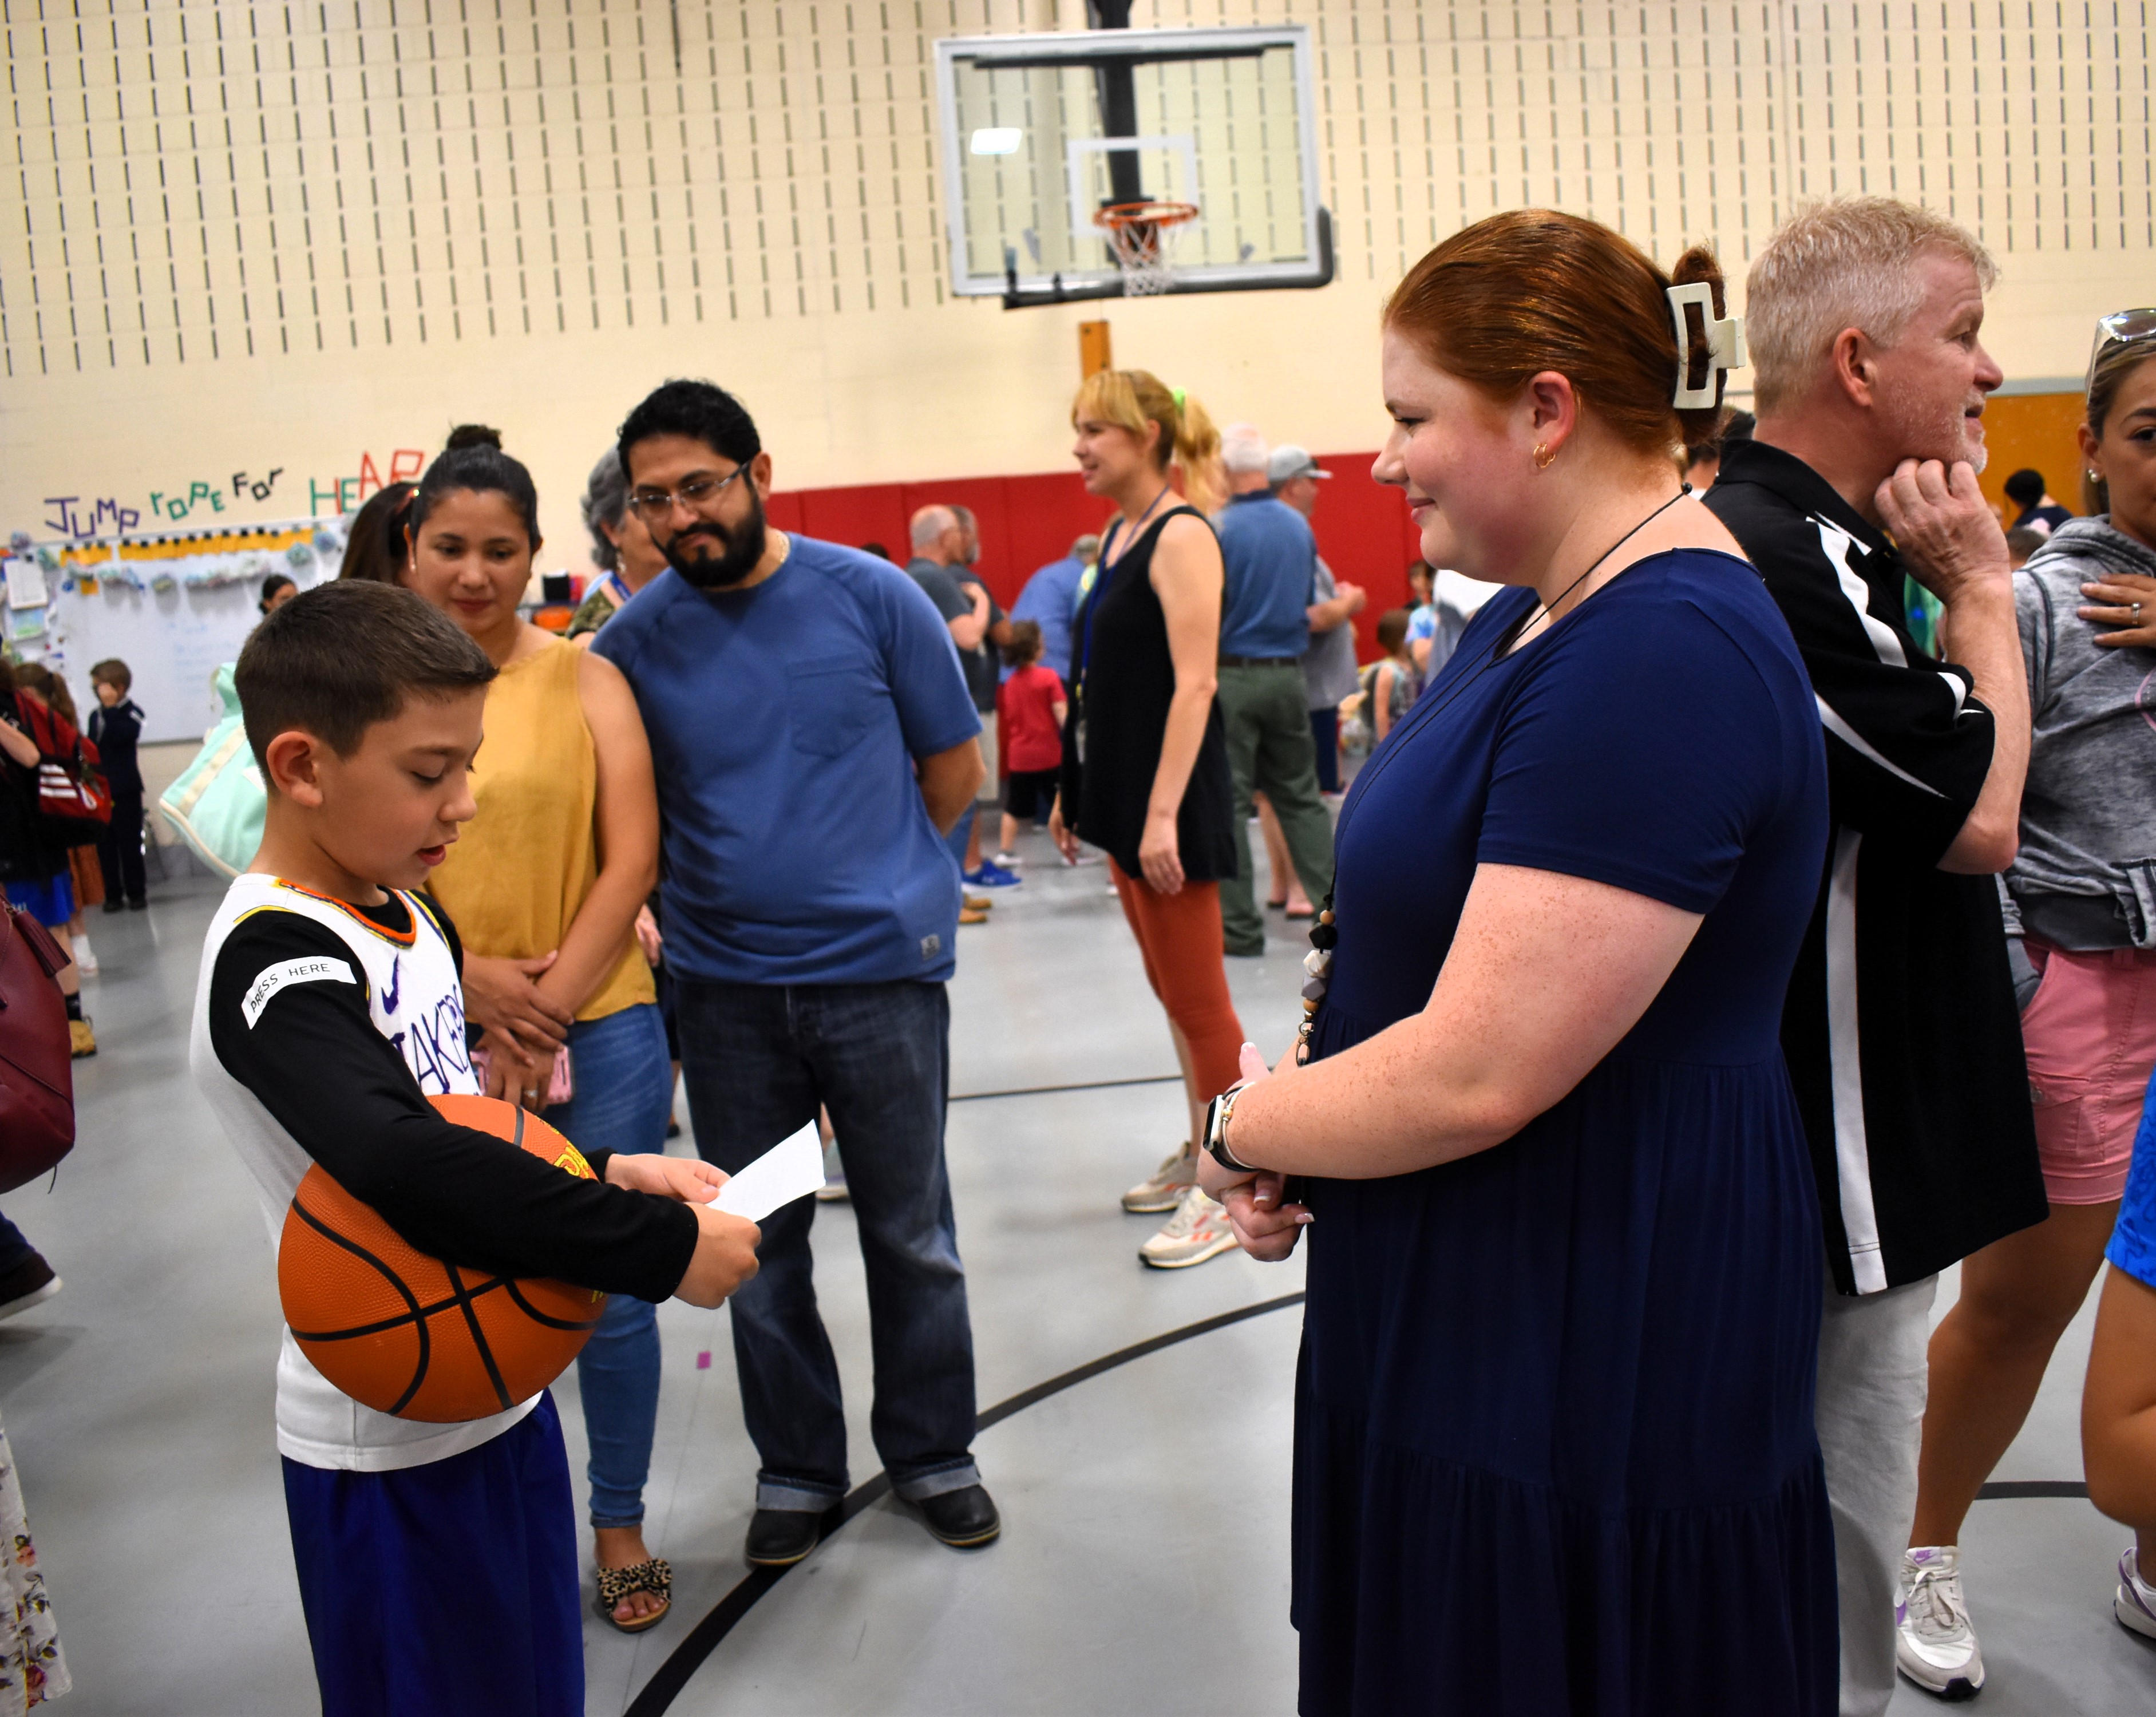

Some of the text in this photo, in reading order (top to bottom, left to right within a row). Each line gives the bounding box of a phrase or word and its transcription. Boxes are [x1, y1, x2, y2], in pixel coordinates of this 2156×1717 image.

[44, 496, 140, 539] JUMP
[250, 963, 331, 1013] PRESS HERE
